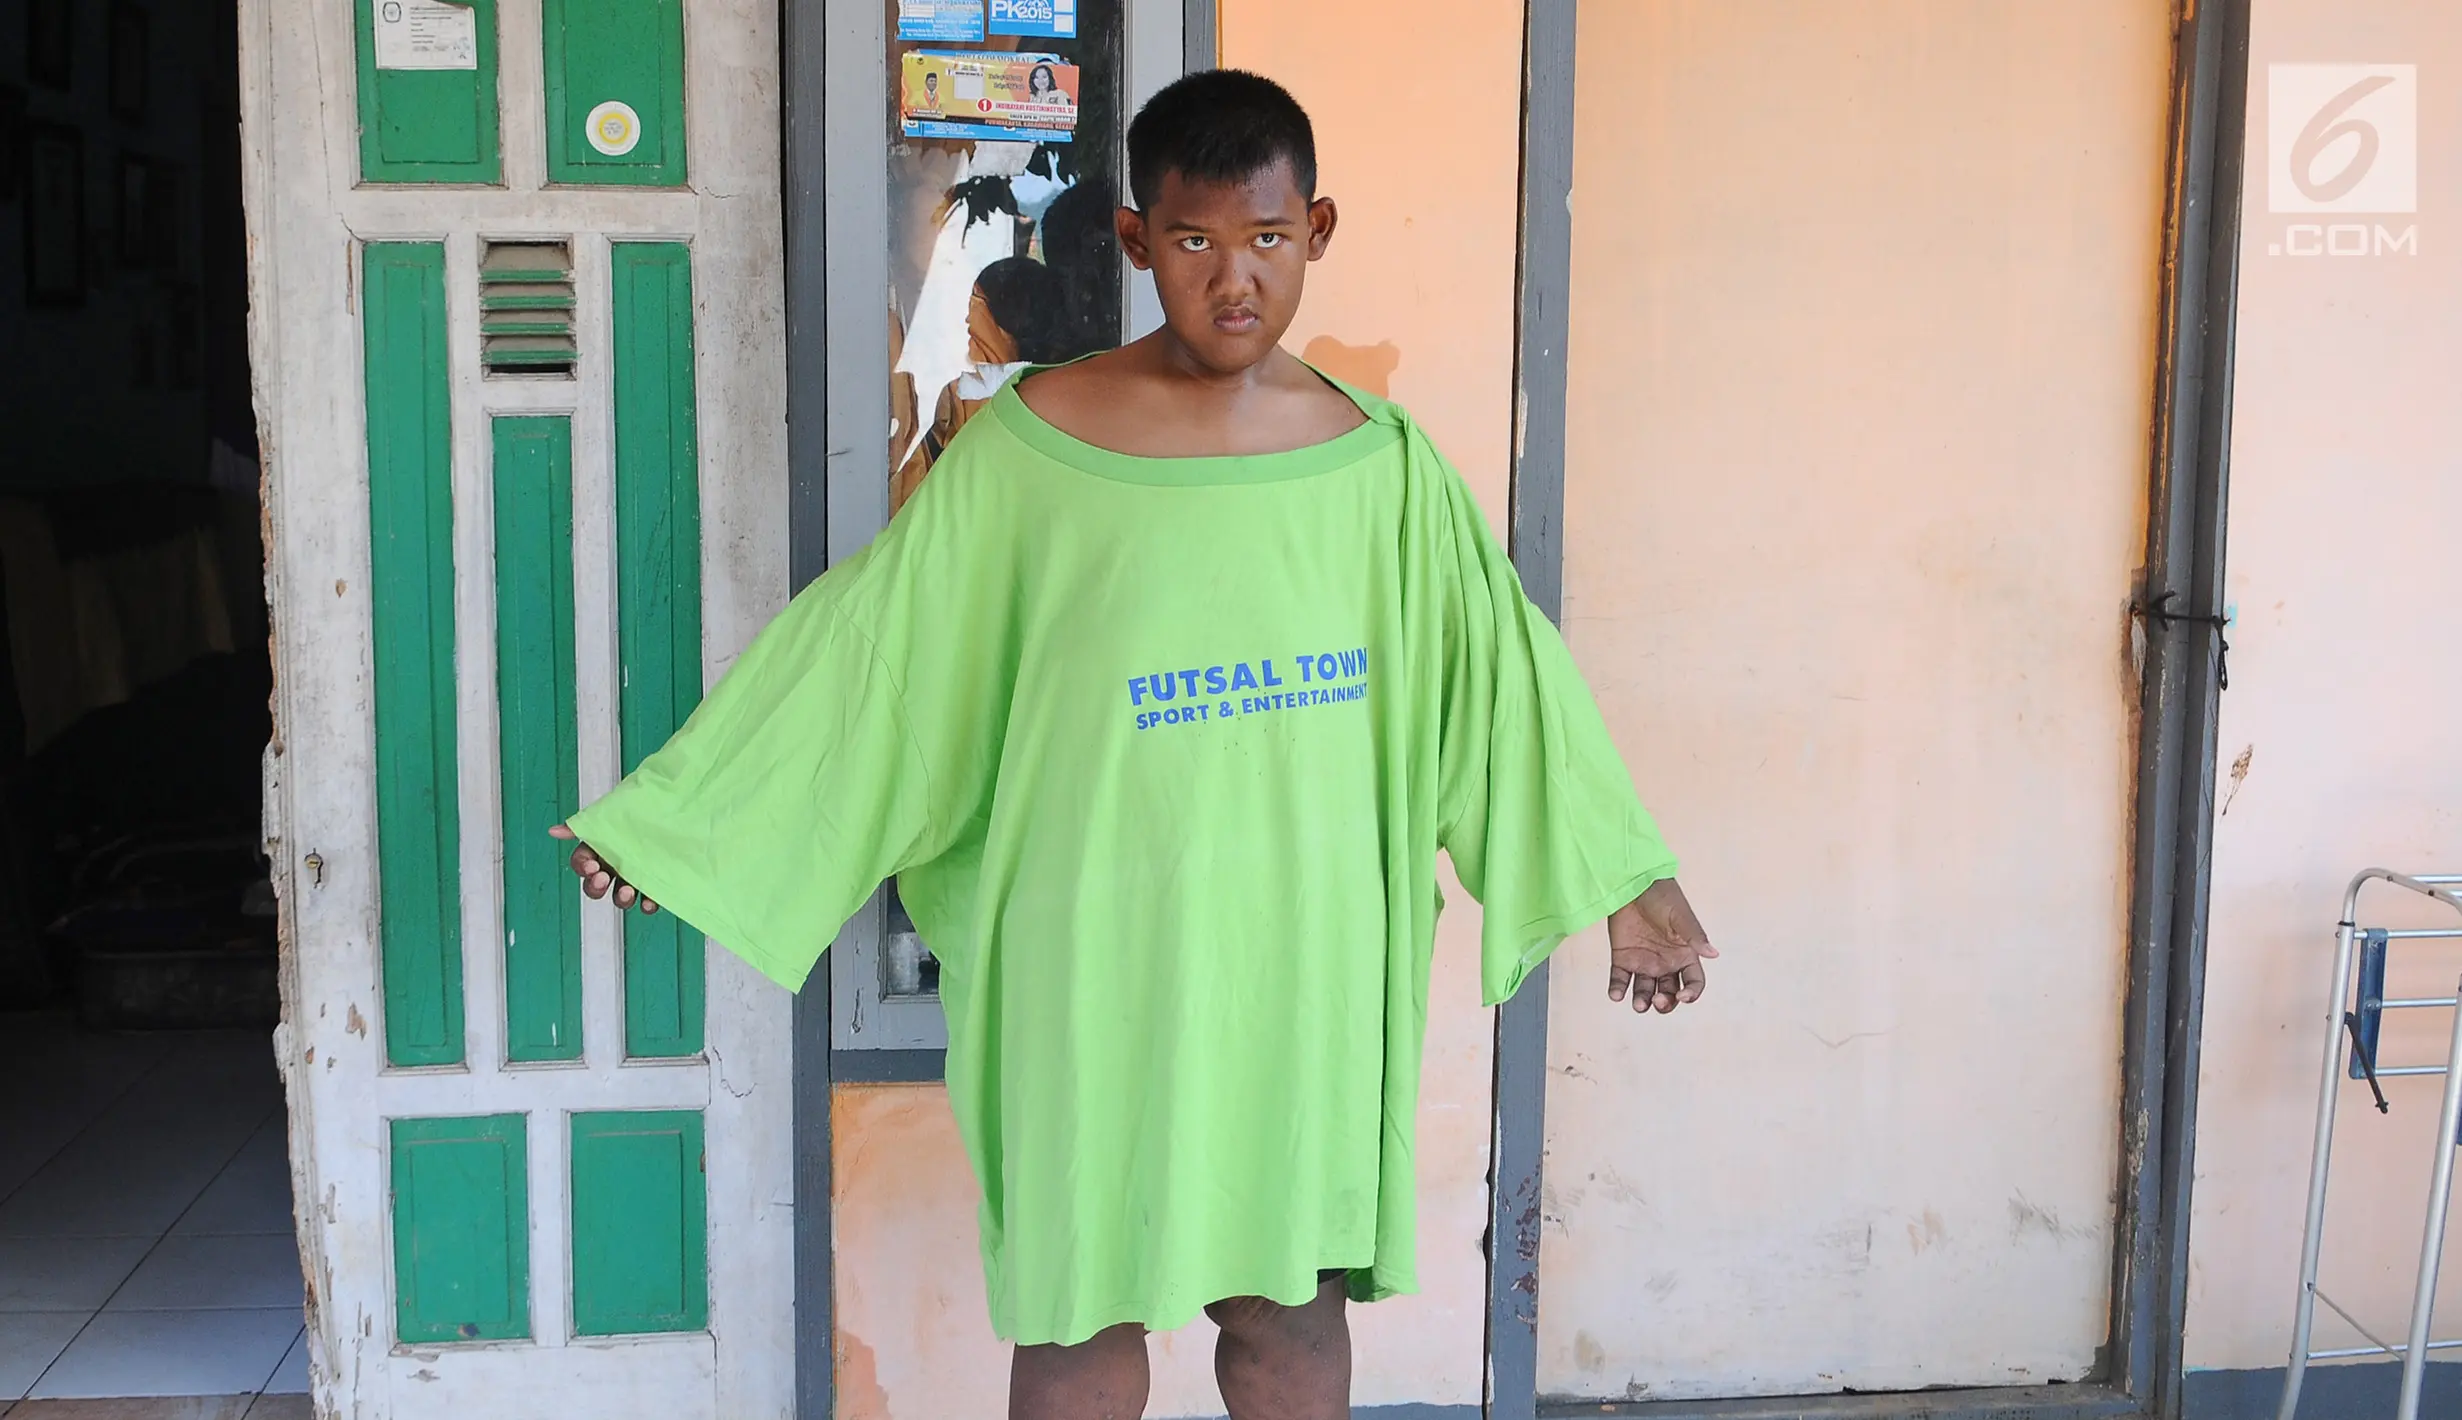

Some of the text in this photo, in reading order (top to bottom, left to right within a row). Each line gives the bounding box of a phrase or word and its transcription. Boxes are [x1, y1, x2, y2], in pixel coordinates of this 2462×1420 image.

[1127, 648, 1368, 706] FUTSAL TOWN
[1136, 682, 1368, 730] SPORT & ENTERTAINMENT
